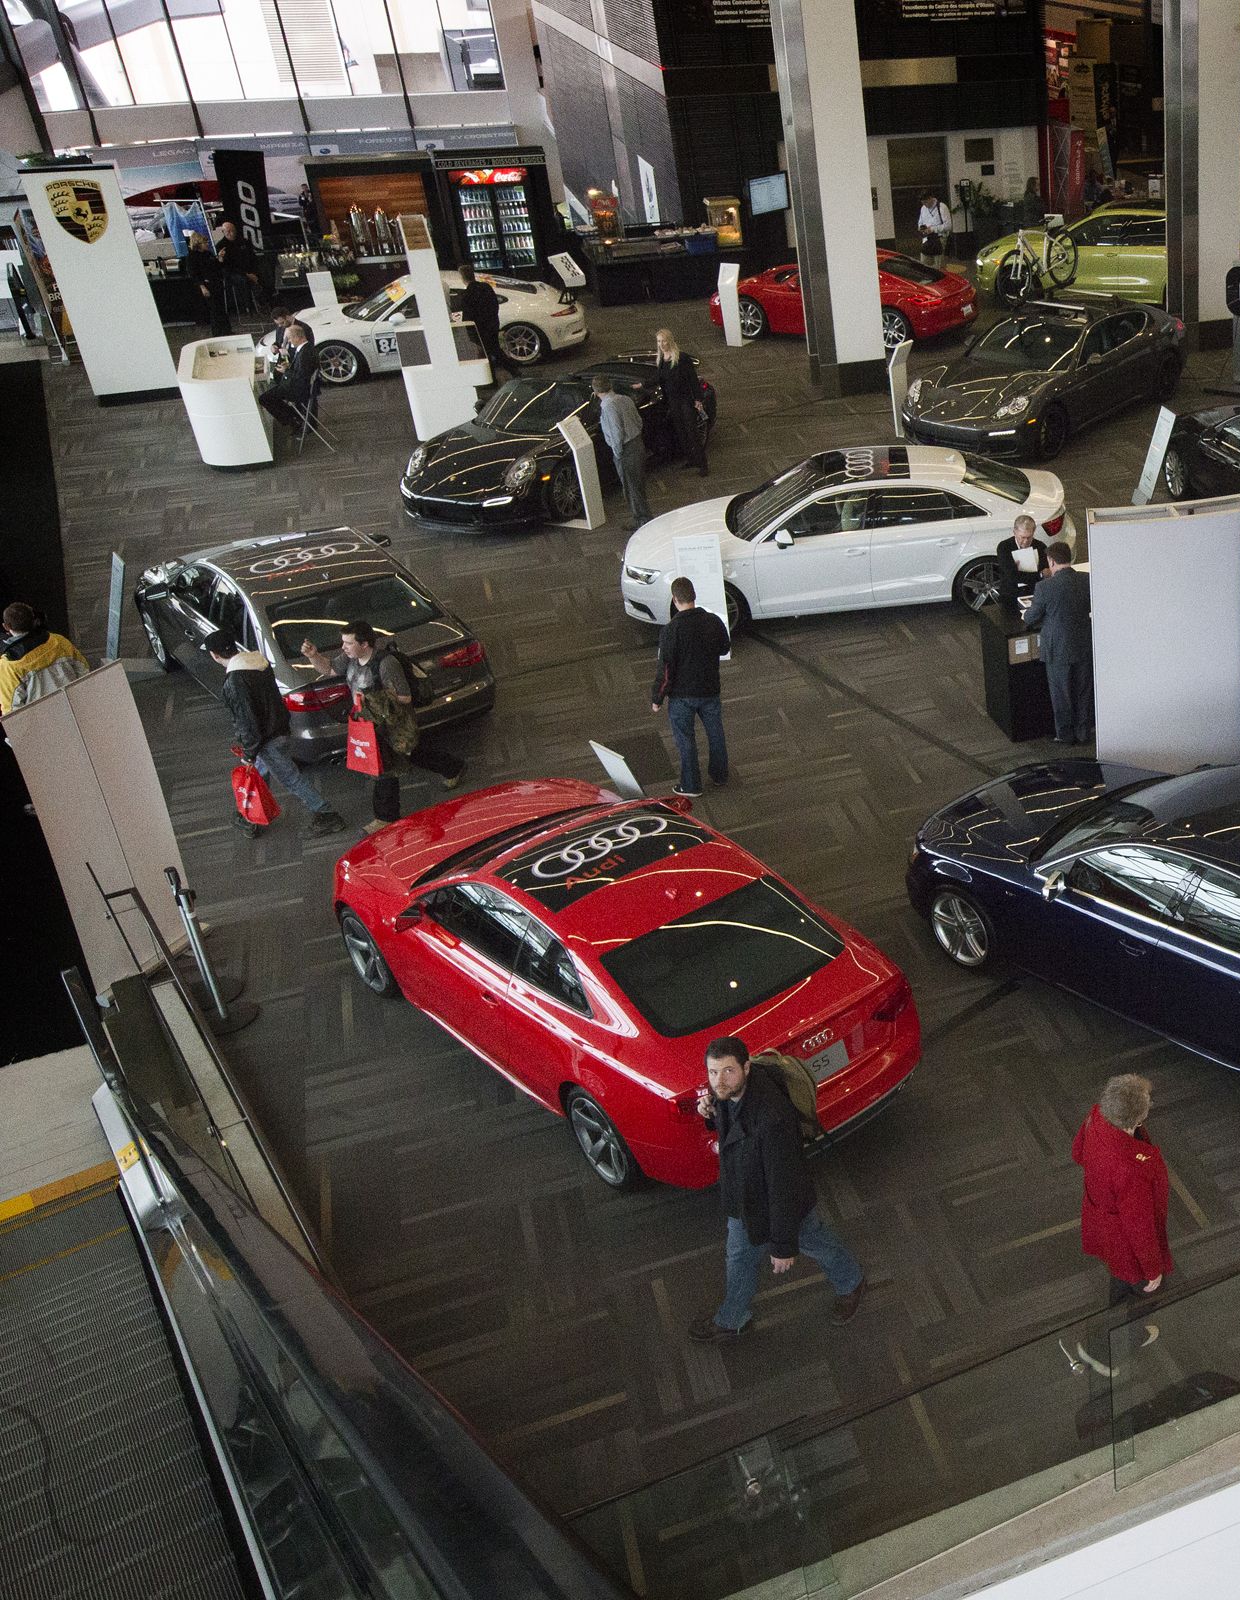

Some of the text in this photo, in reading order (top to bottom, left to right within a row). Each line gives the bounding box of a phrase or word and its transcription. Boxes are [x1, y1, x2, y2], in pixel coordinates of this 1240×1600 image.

[152, 146, 197, 157] LEGACY
[437, 161, 453, 169] COLD
[45, 180, 99, 191] PORSCHE
[566, 854, 626, 891] Audi
[812, 1054, 831, 1073] S5
